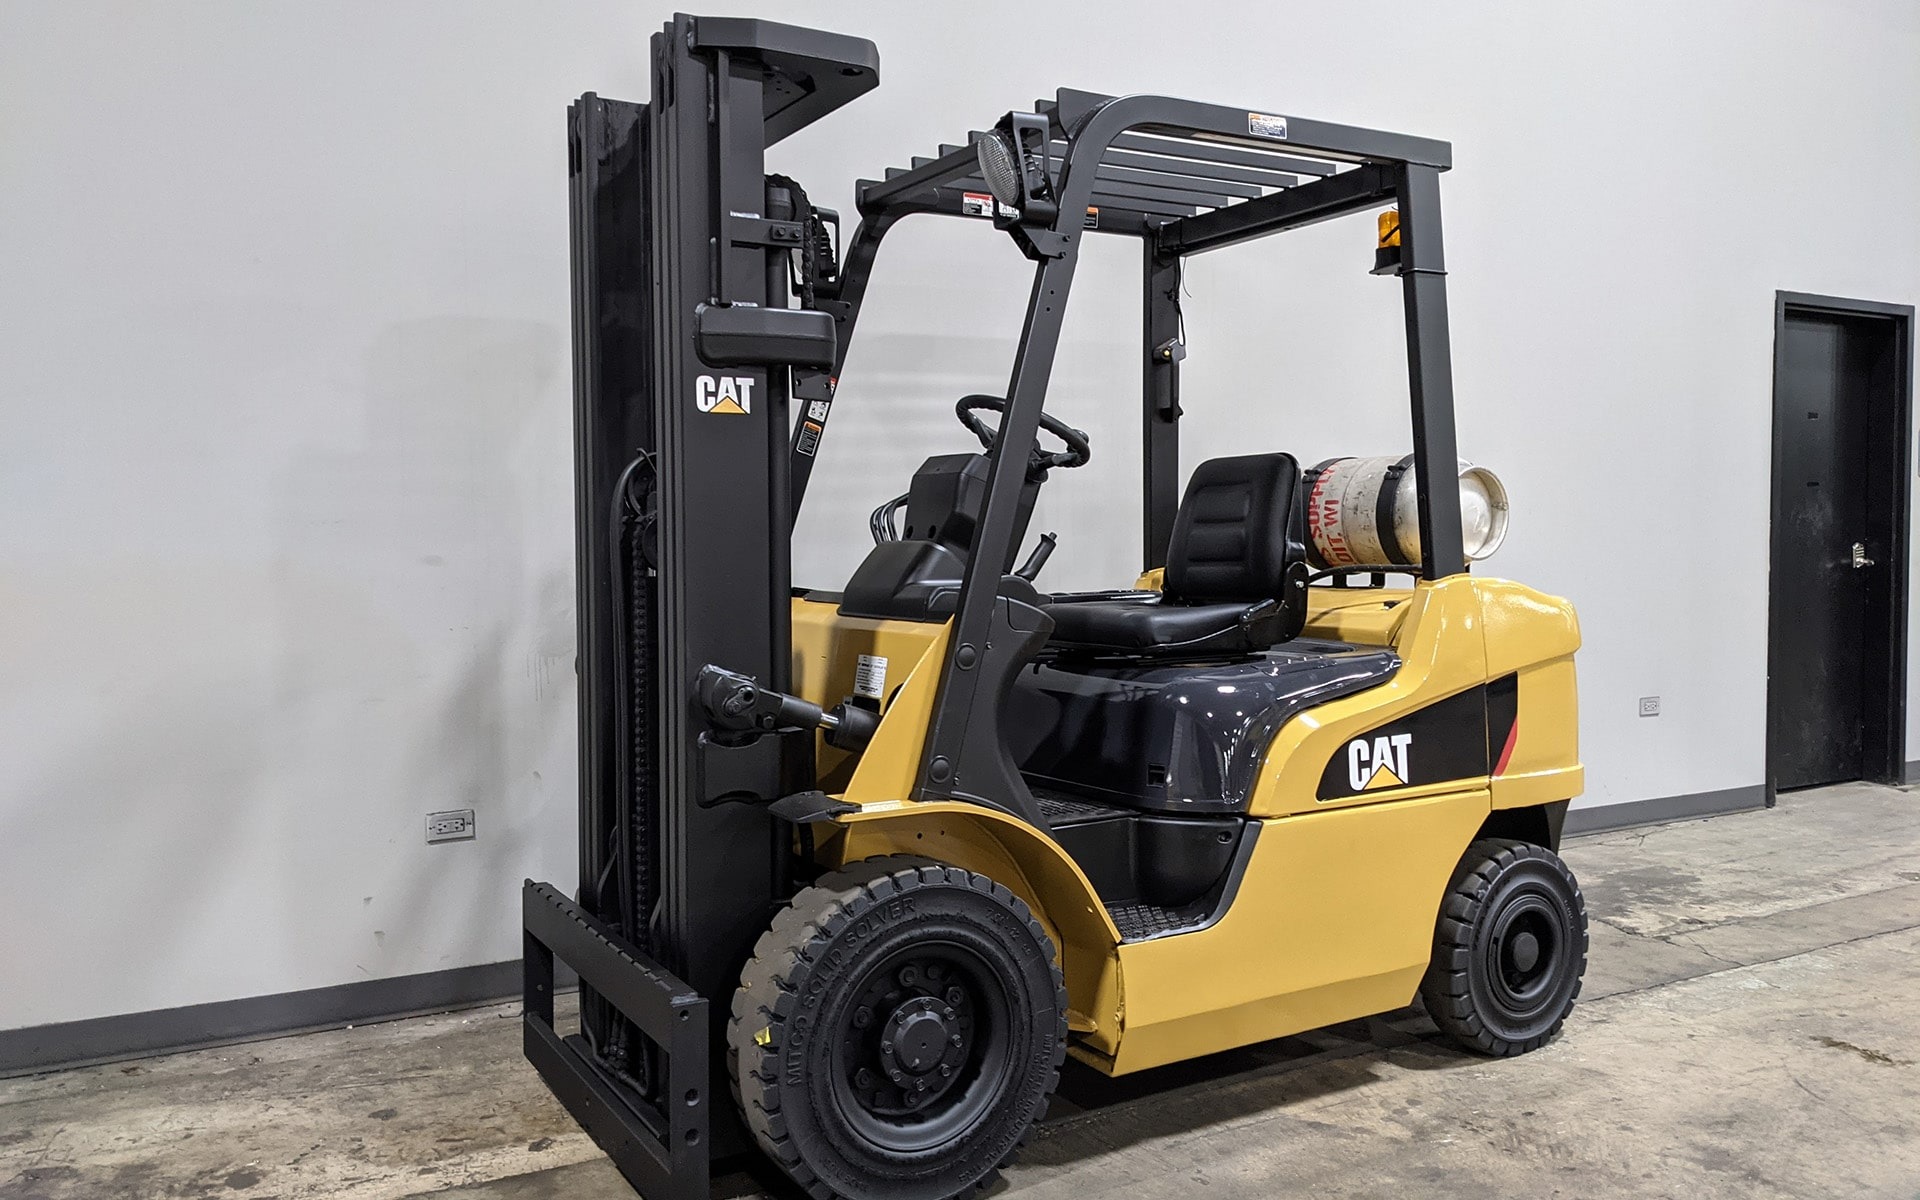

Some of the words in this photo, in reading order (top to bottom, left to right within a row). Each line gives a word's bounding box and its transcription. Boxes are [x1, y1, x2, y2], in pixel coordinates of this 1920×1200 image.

[696, 376, 754, 414] CAT
[1324, 500, 1339, 527] WI
[1349, 734, 1412, 791] CAT
[803, 948, 842, 1008] SOLID
[845, 897, 915, 947] SOLVER
